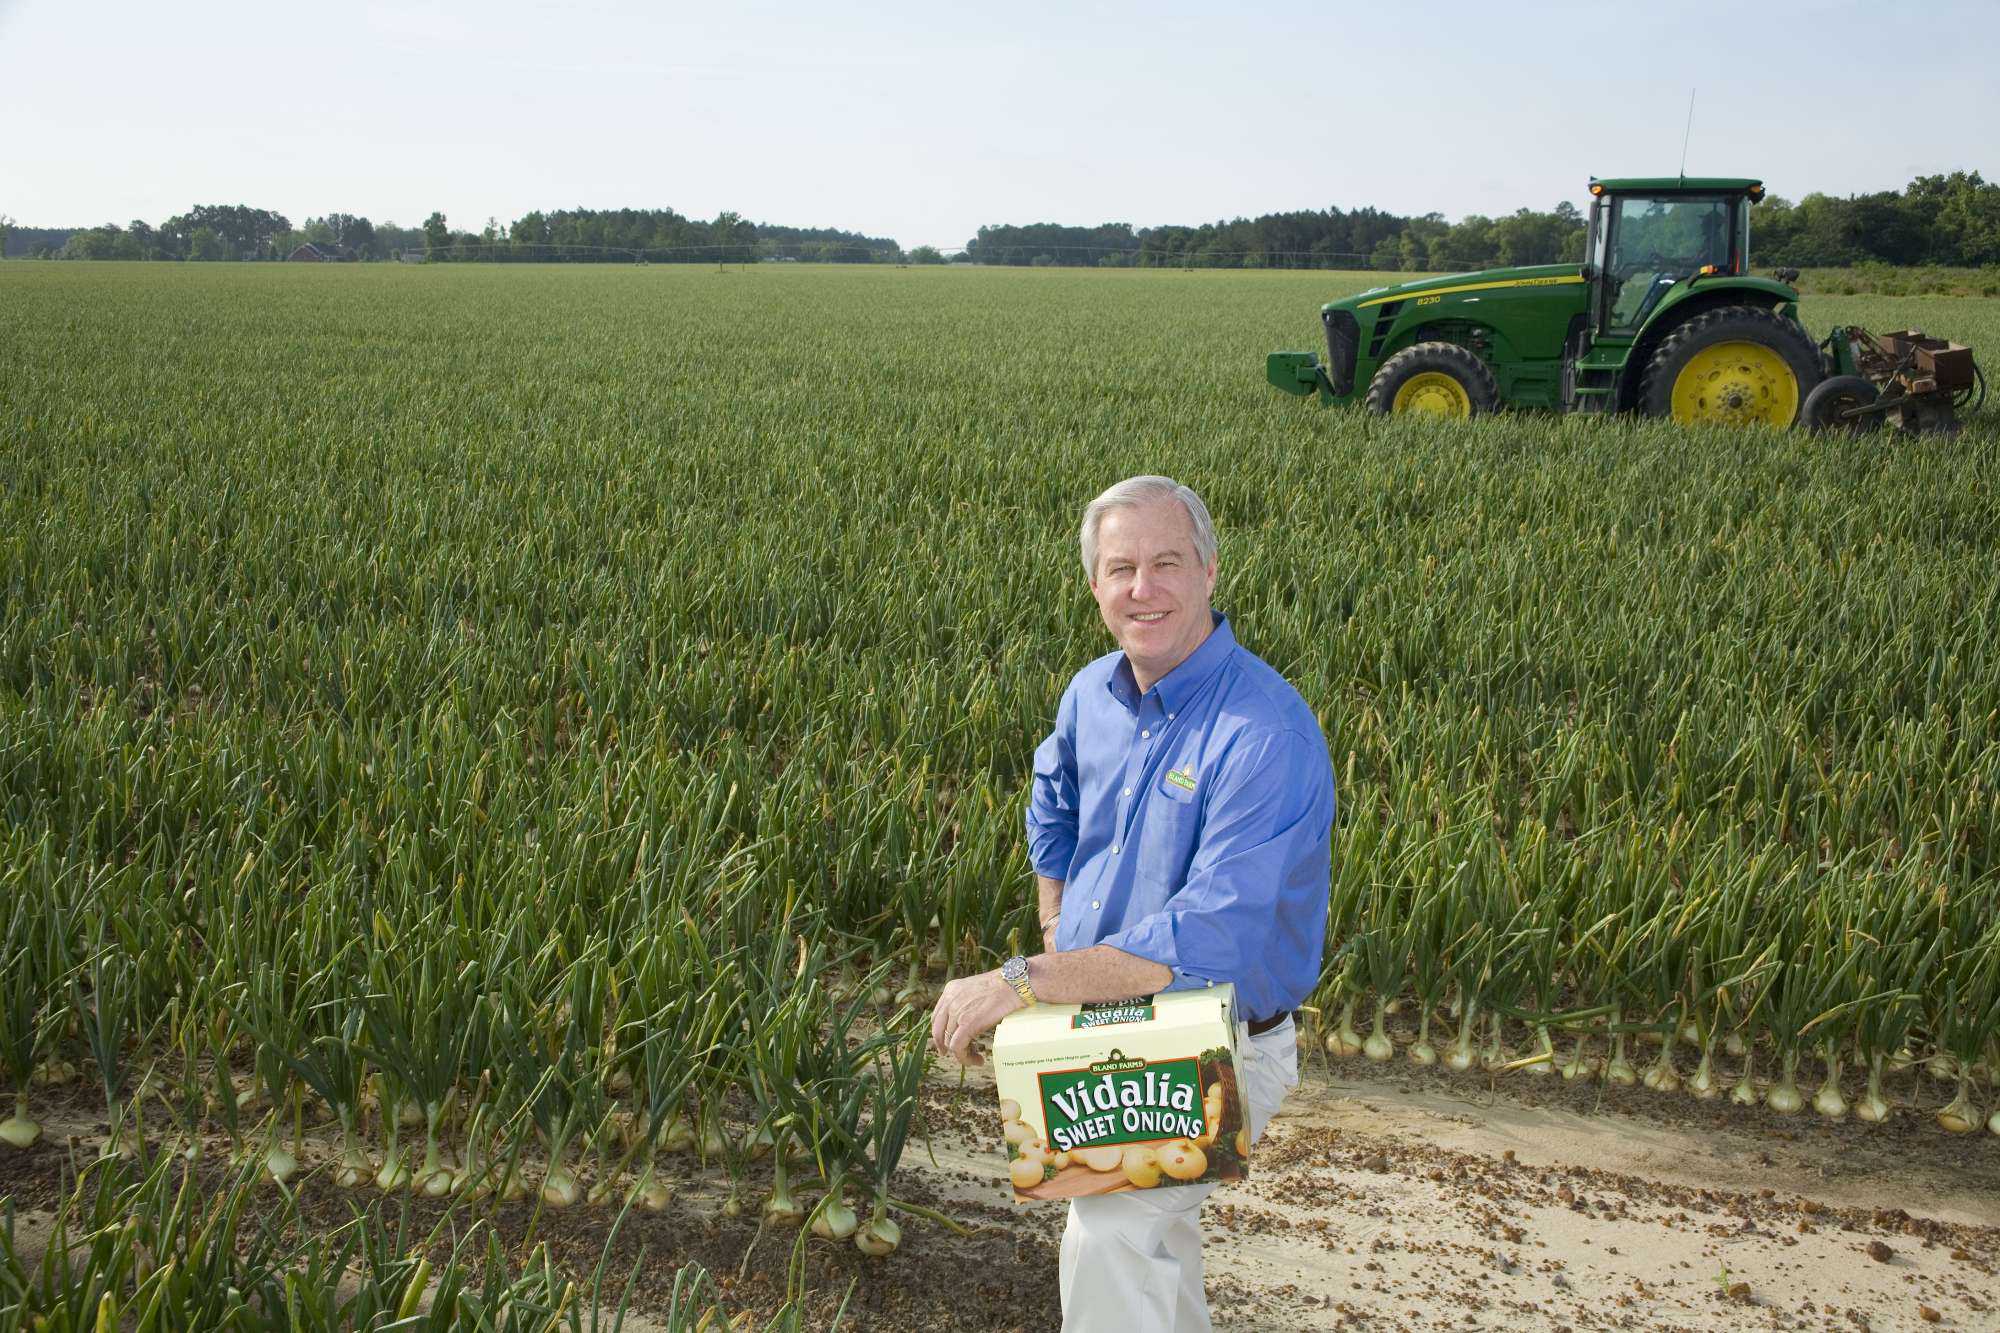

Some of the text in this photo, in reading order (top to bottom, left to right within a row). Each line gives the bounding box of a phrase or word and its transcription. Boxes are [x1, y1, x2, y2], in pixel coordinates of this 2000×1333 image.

[1083, 1006, 1145, 1021] Vidalia
[1081, 1018, 1110, 1029] SWEET
[1092, 1061, 1144, 1072] BLAND FARMS
[1052, 1071, 1193, 1122] Vidalia
[1053, 1107, 1203, 1152] SWEET ONIONS
